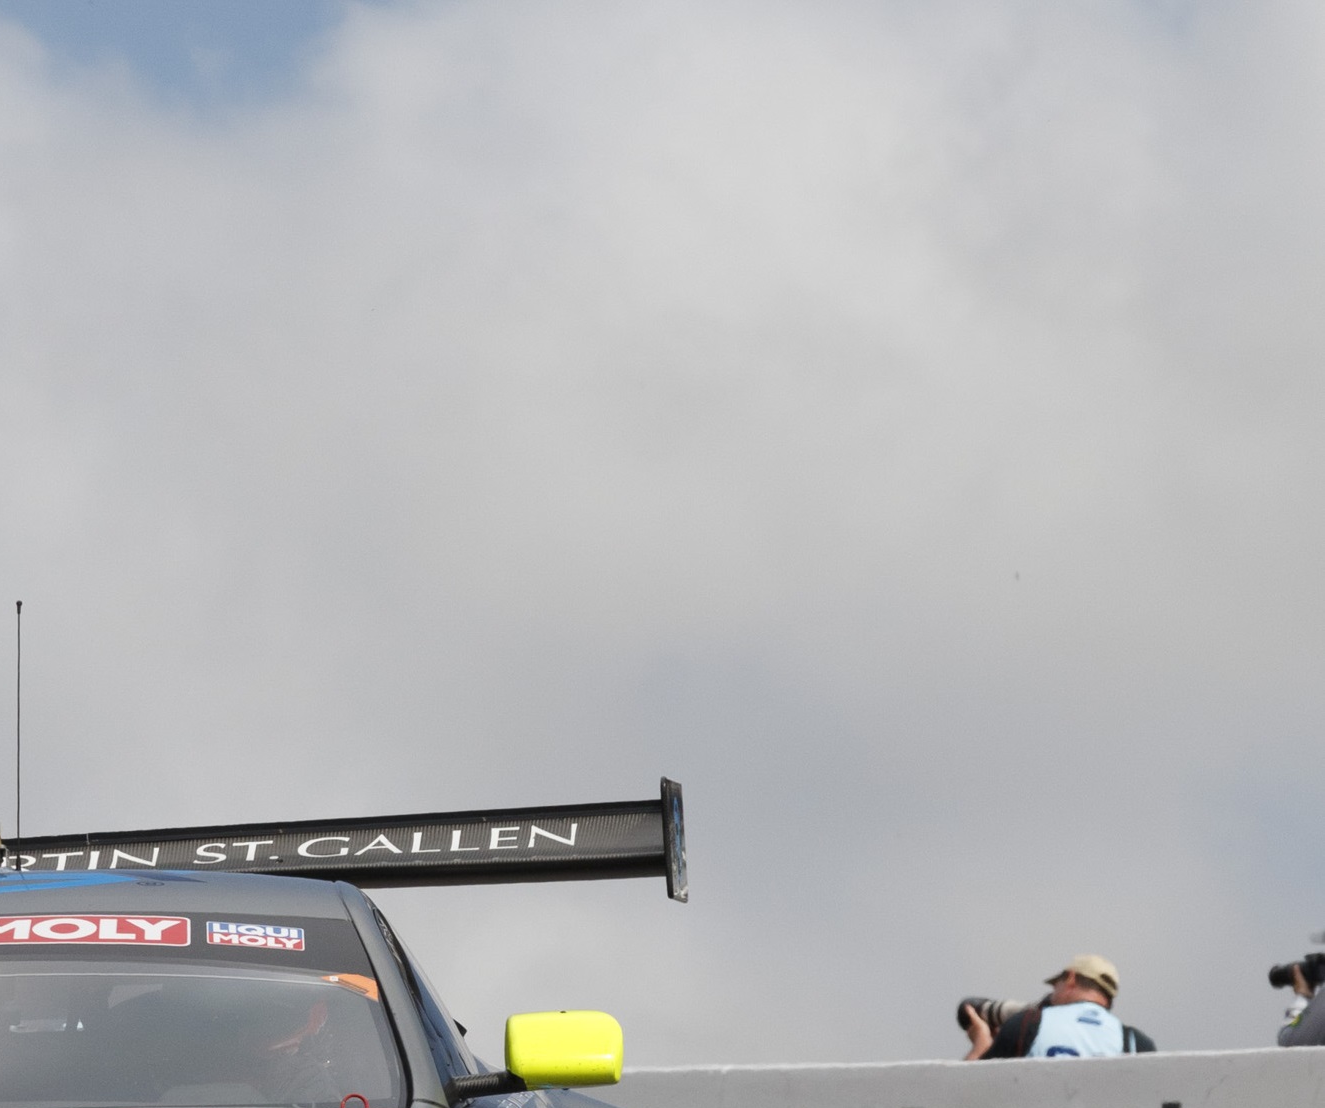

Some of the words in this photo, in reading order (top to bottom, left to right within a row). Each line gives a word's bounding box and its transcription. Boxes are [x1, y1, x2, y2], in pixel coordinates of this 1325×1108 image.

[193, 840, 279, 865] ST.
[297, 823, 578, 858] GALLEN
[212, 922, 303, 939] LIQUI
[212, 932, 304, 949] MOLY
